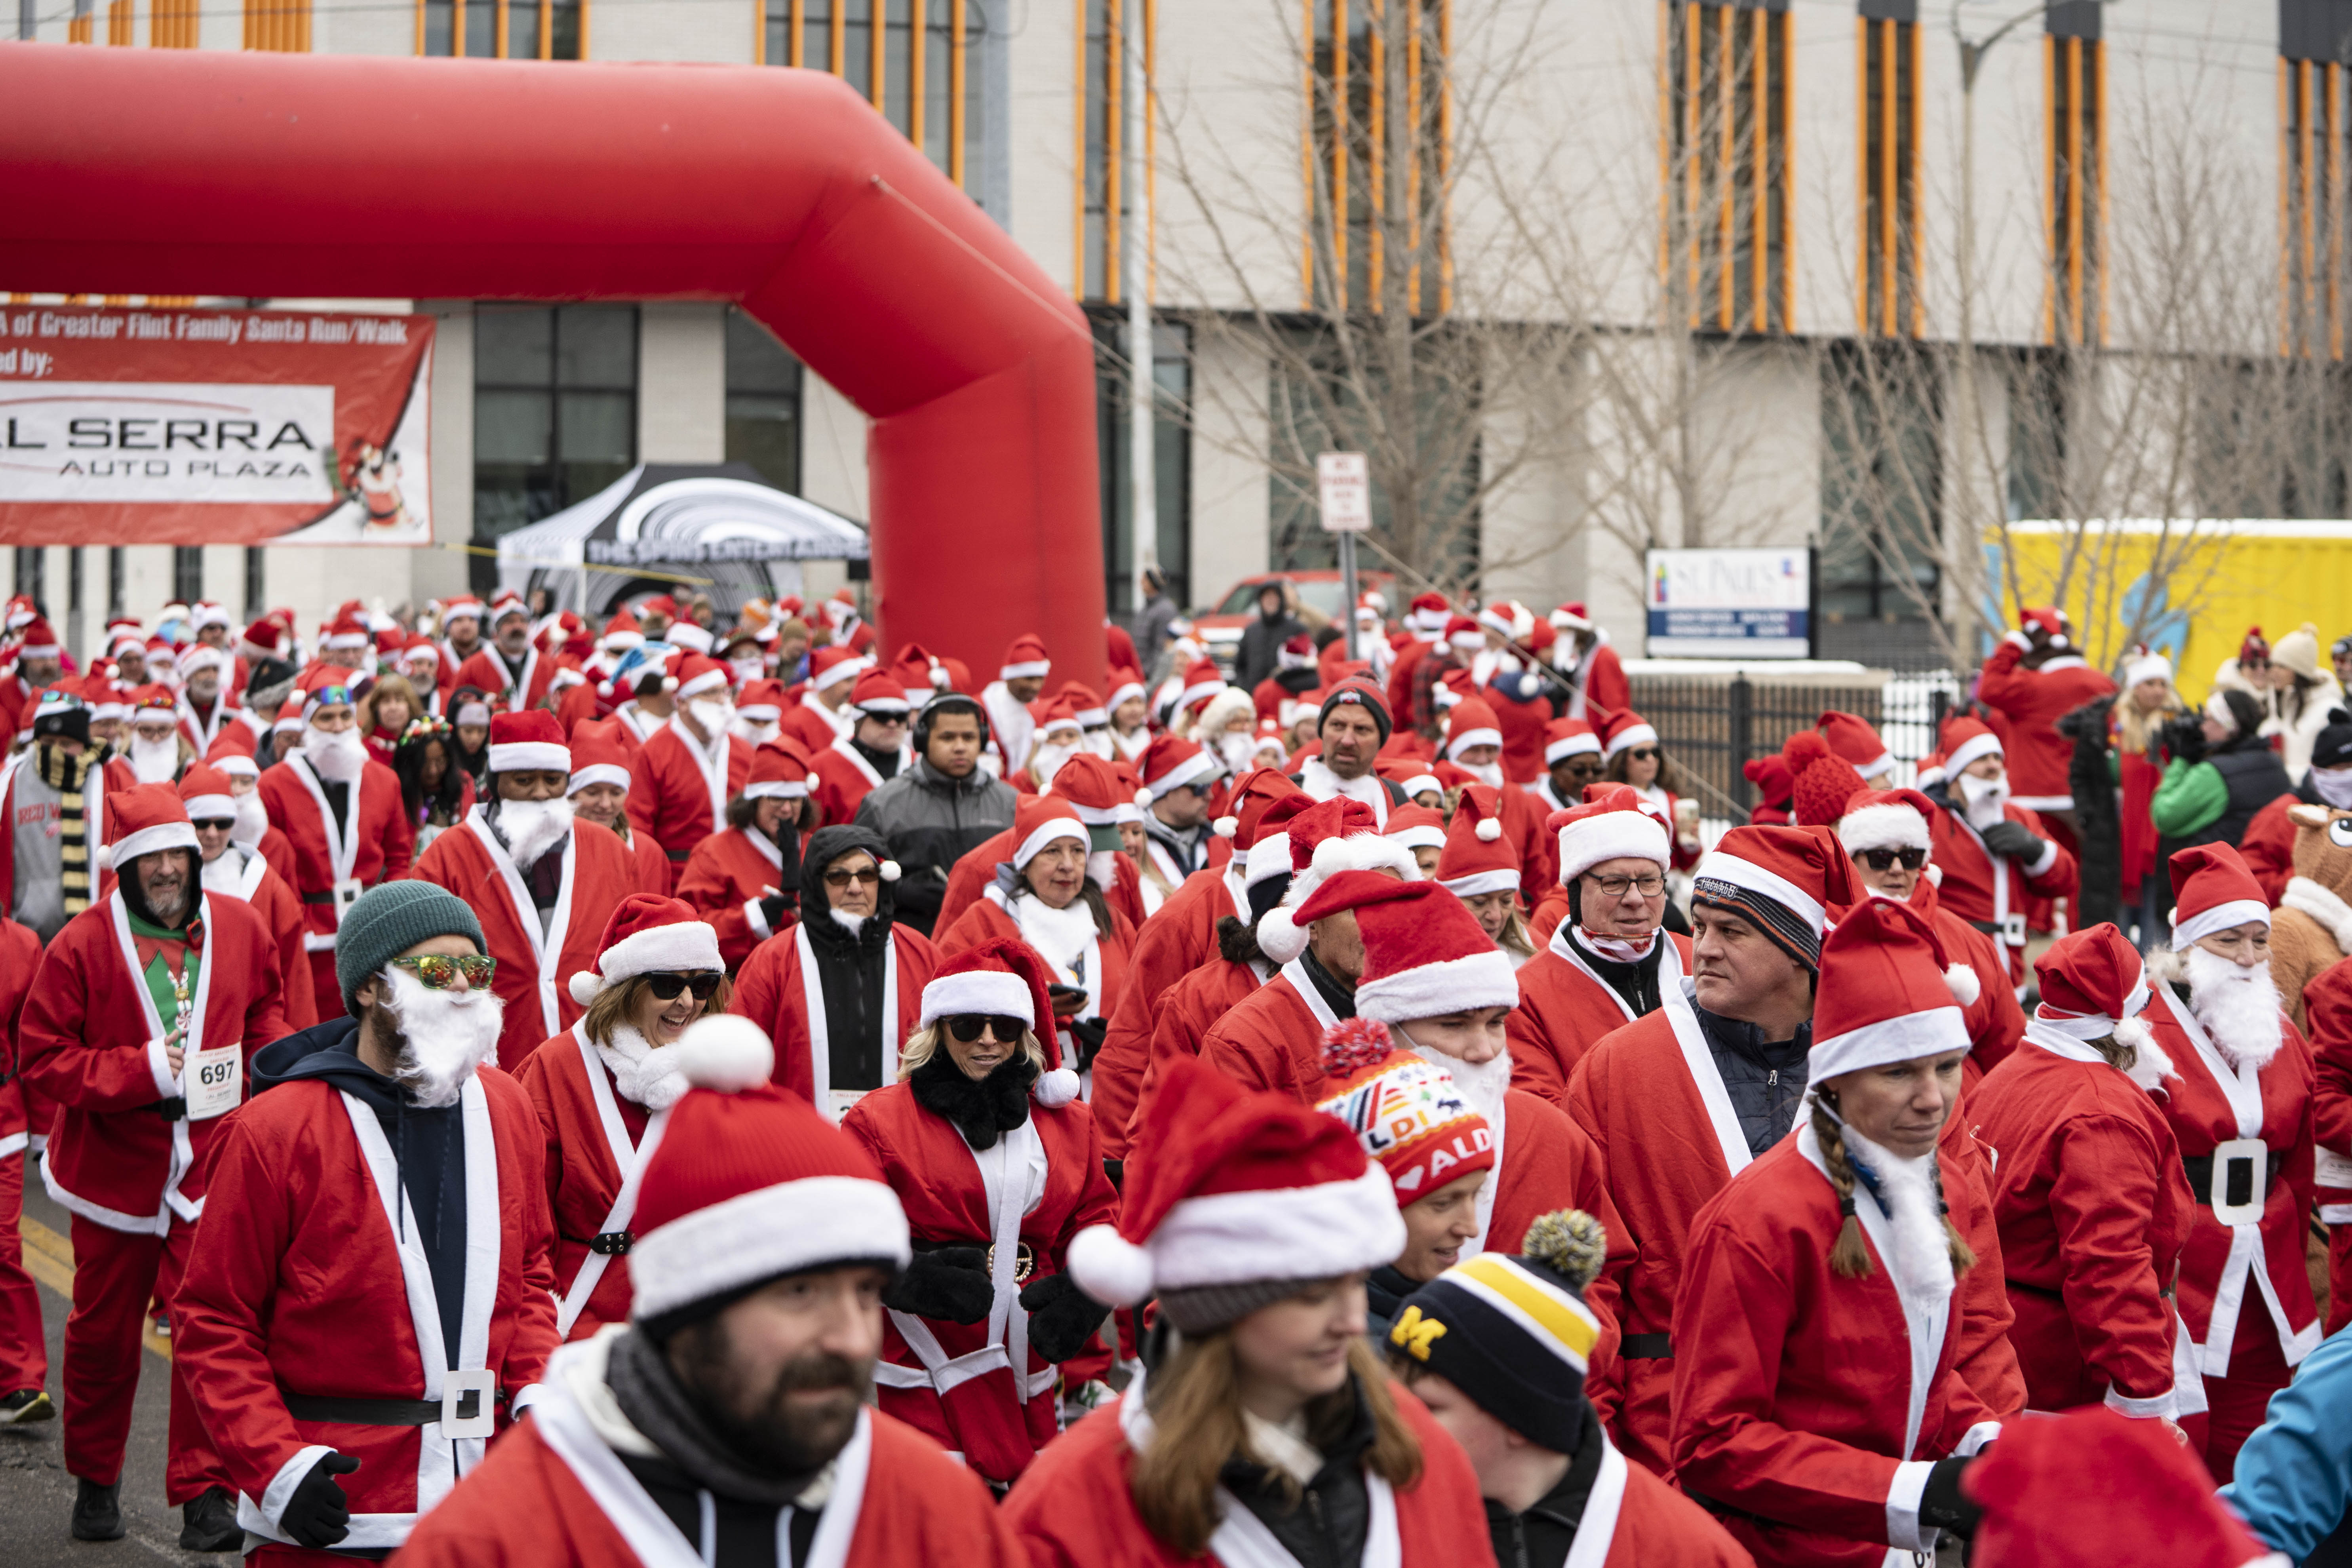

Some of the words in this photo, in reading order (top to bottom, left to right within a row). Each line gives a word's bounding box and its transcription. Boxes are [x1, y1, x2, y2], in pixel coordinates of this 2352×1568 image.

[13, 310, 36, 337] of
[40, 311, 124, 339] Greater
[126, 313, 173, 340] Flint
[176, 313, 242, 345] Family
[246, 314, 306, 343] Santa
[308, 317, 408, 345] Run/Walk
[20, 347, 53, 379] by:
[0, 417, 48, 449] L
[68, 418, 316, 451] SERRA
[59, 459, 169, 477] AUTO
[188, 460, 312, 478] PLAZA
[17, 803, 46, 826] RED
[1700, 879, 1737, 898] FIREBIRDS
[201, 1059, 235, 1085] 697
[1390, 1305, 1448, 1362] M
